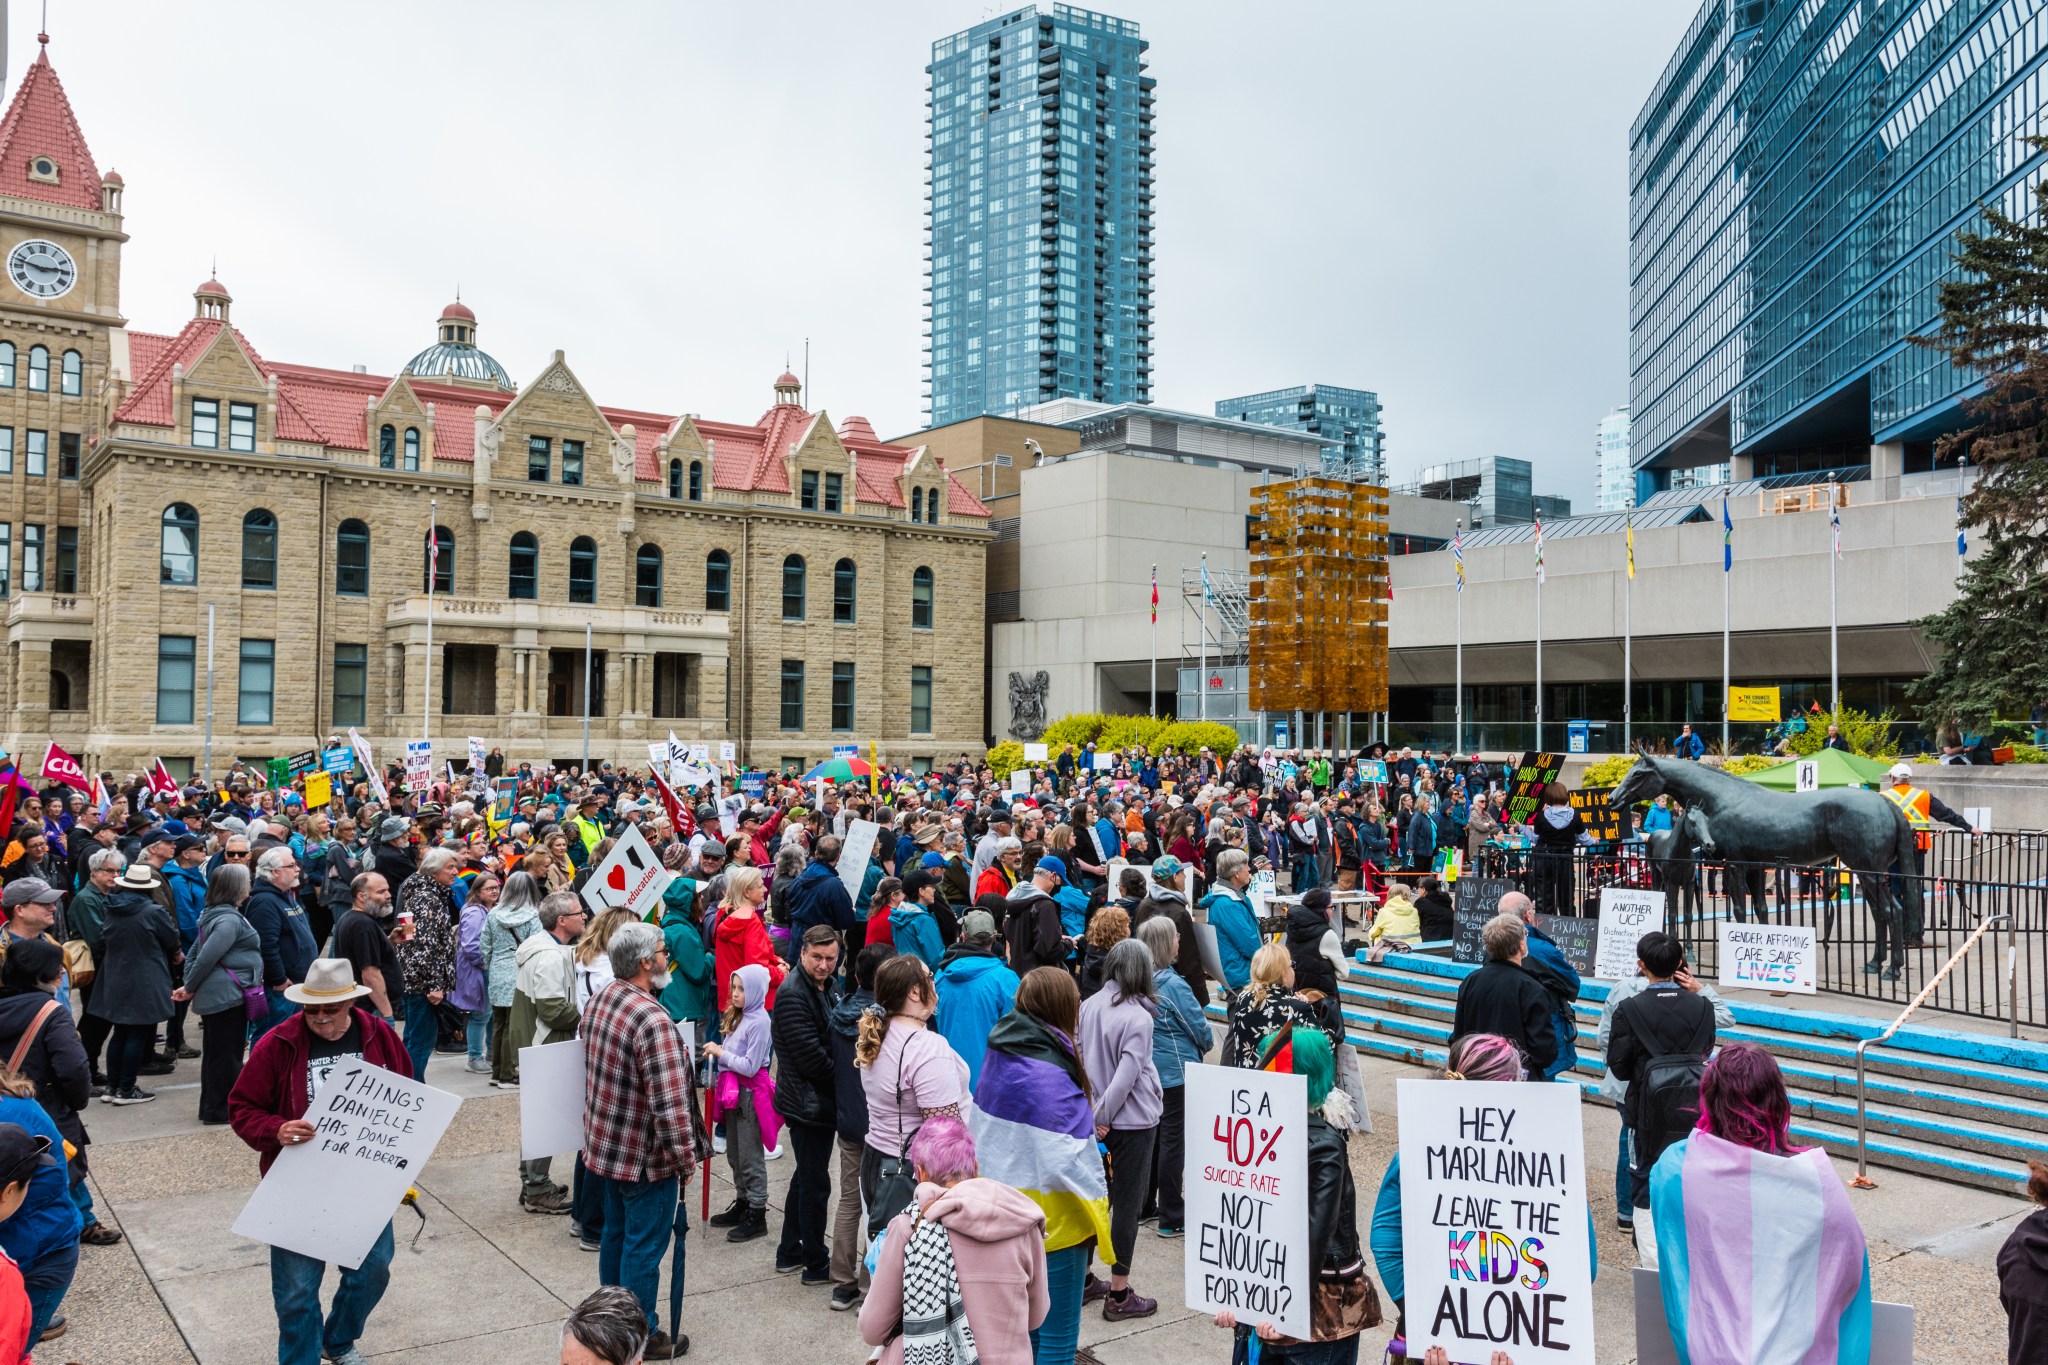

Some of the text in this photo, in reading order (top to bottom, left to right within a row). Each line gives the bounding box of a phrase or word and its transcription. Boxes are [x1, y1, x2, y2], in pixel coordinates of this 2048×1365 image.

[408, 743, 416, 751] WE
[670, 742, 690, 764] NA
[407, 754, 430, 766] WE FIGHT
[408, 770, 430, 782] ALBERTA
[1516, 766, 1540, 782] HANDS
[412, 781, 426, 790] KIDS
[1508, 796, 1540, 812] PETITION
[627, 866, 658, 905] education
[1462, 881, 1477, 897] NO
[1459, 898, 1472, 910] NO
[1612, 902, 1652, 914] ANOTHER
[1457, 911, 1468, 922] NO
[1618, 914, 1646, 926] UCP
[1604, 926, 1635, 938] Distraction
[1728, 930, 1809, 950] GENDER AFFIRMING
[1456, 942, 1472, 953] NO
[1734, 946, 1802, 964] CARE SAVES
[1736, 962, 1796, 984] LIVES
[344, 1068, 424, 1112] THINGS
[328, 1094, 415, 1134] DANIELLE
[1231, 1089, 1272, 1118] IS A
[314, 1116, 399, 1148] HAS DONE
[1214, 1114, 1284, 1168] 40%
[322, 1139, 408, 1170] FOR ALBERTA
[1204, 1165, 1281, 1197] SUICIDE RATE
[1426, 1144, 1567, 1197] MARLAINA!
[1220, 1191, 1273, 1234] NOT
[1432, 1193, 1561, 1236] LEAVE THE
[1200, 1222, 1287, 1285] ENOUGH
[1448, 1230, 1549, 1290] KIDS
[1205, 1273, 1293, 1323] FOR YOU?
[1430, 1284, 1571, 1352] ALONE
